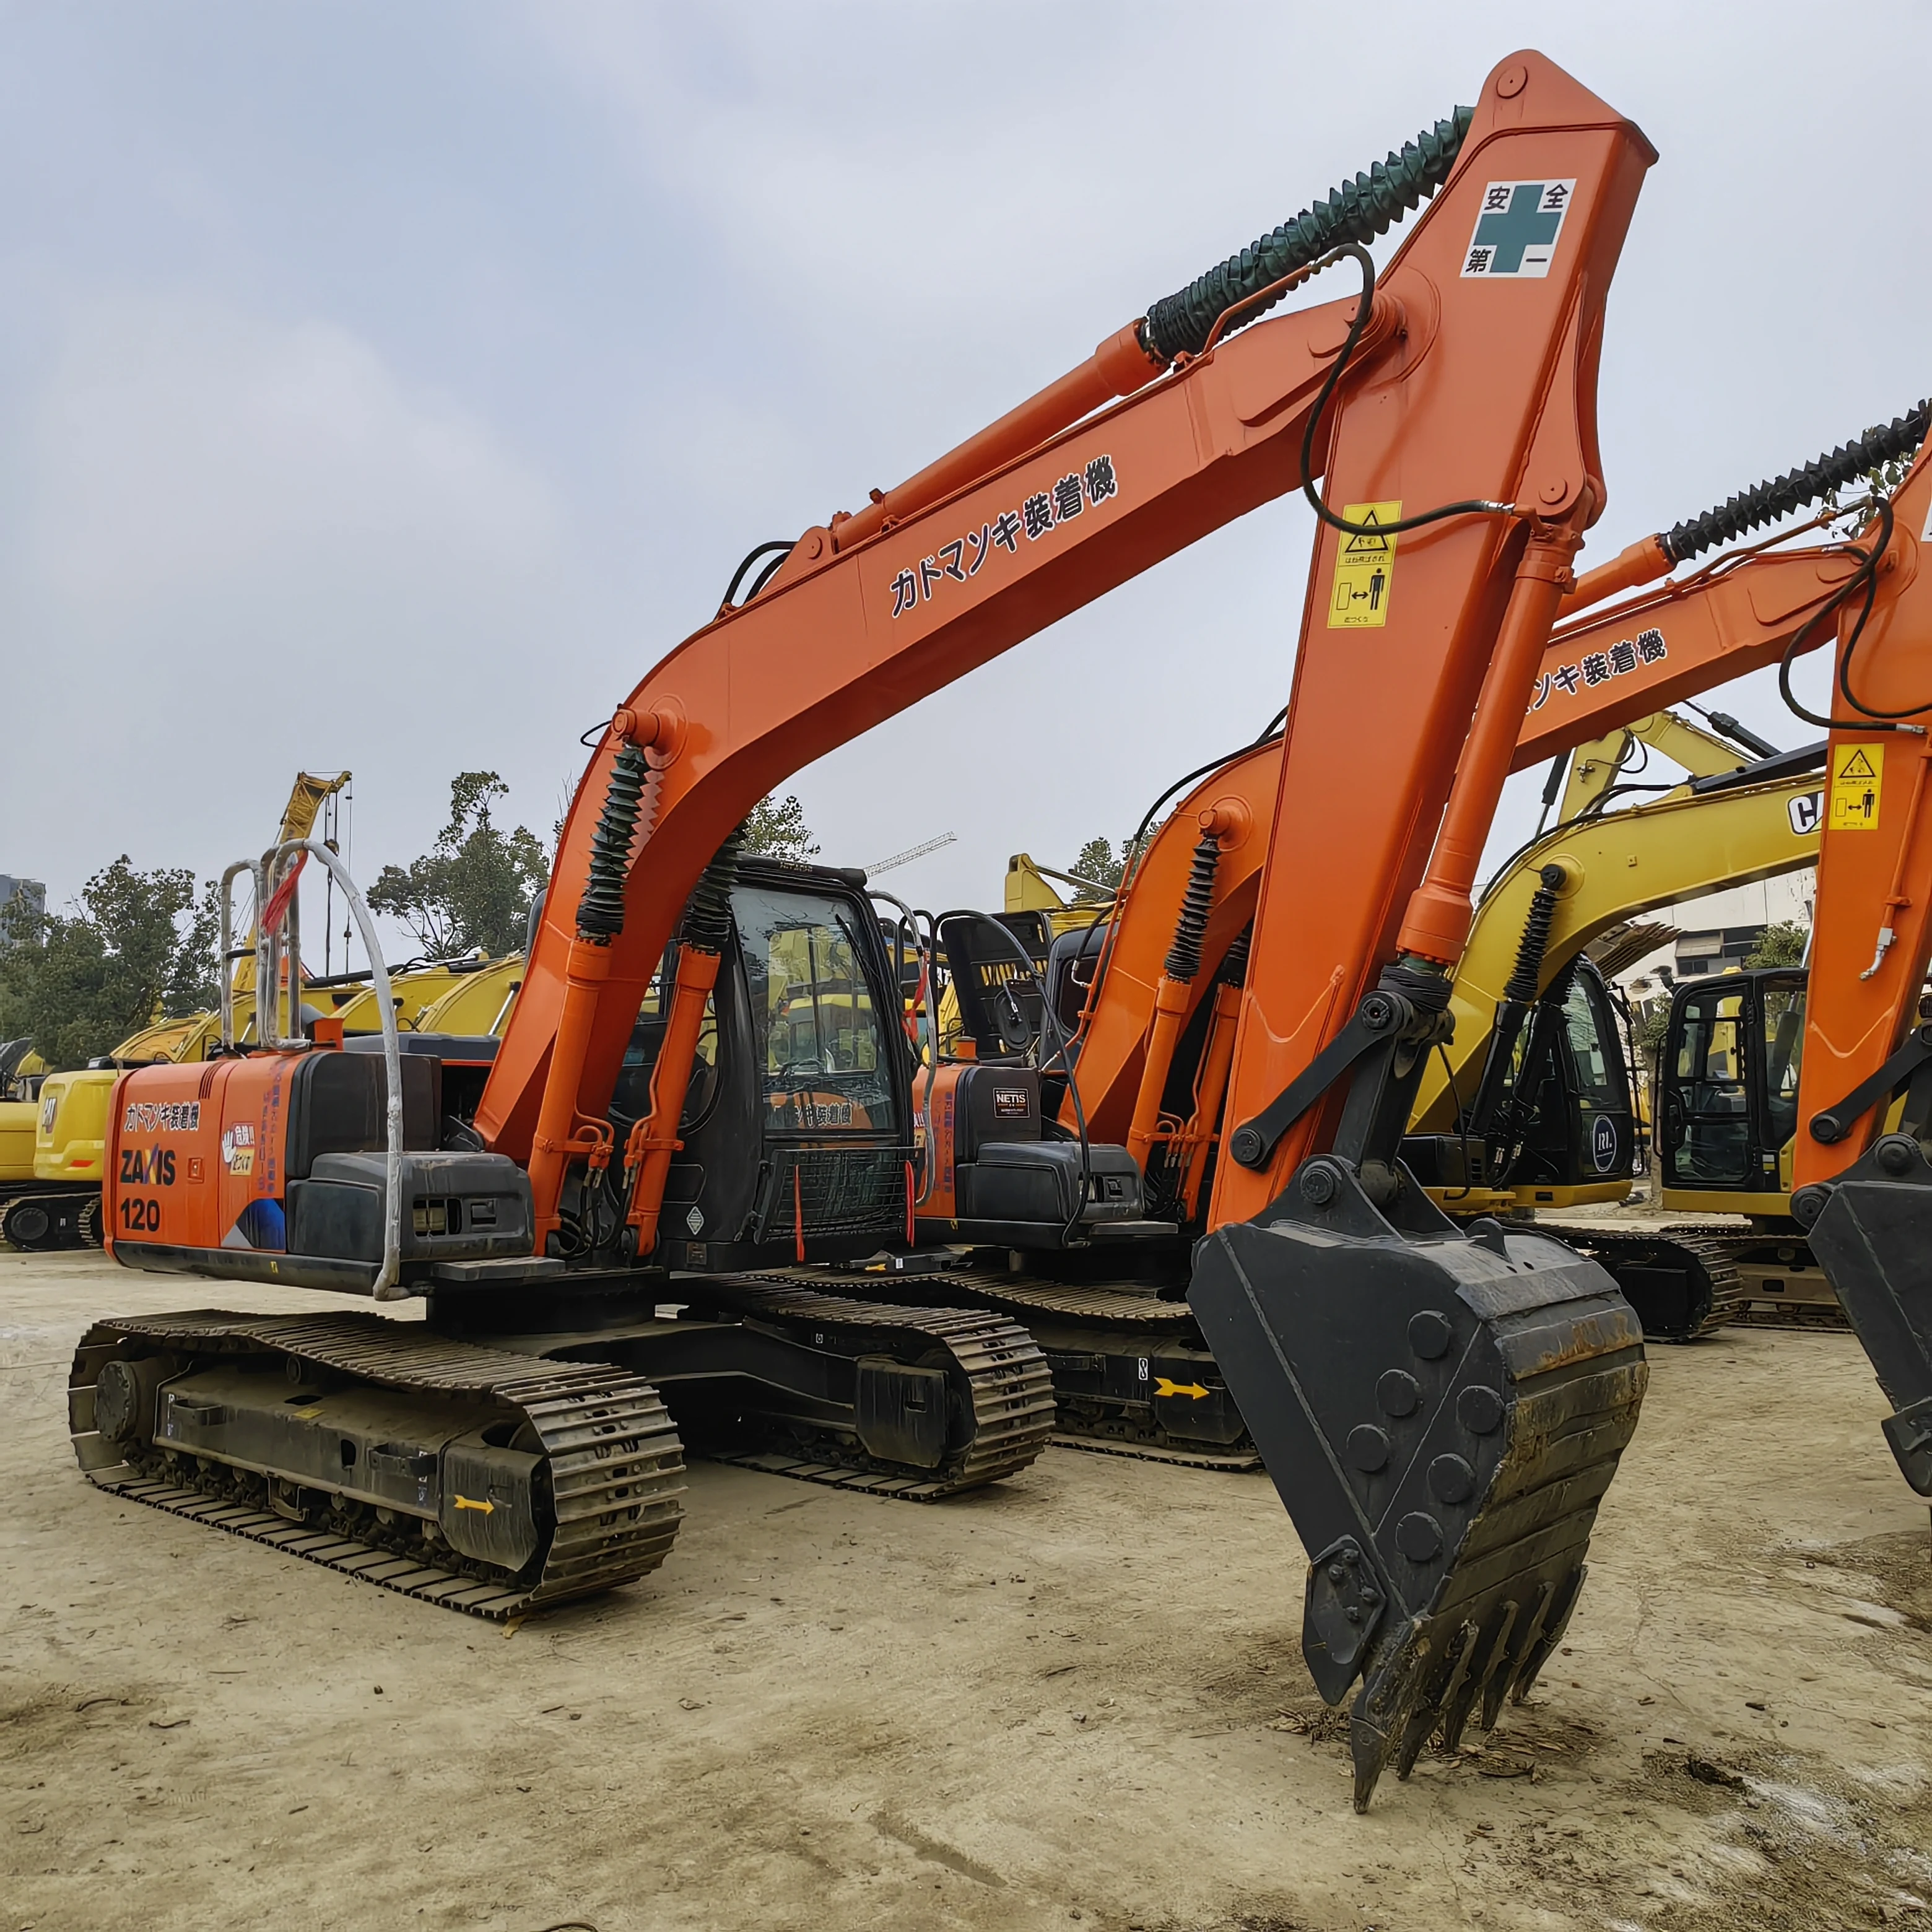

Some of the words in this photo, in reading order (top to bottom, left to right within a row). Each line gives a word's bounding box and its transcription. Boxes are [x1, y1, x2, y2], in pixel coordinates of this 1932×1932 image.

[996, 1094, 1026, 1103] NETIS
[120, 1143, 176, 1186] ZAXIS
[120, 1197, 160, 1232] 120
